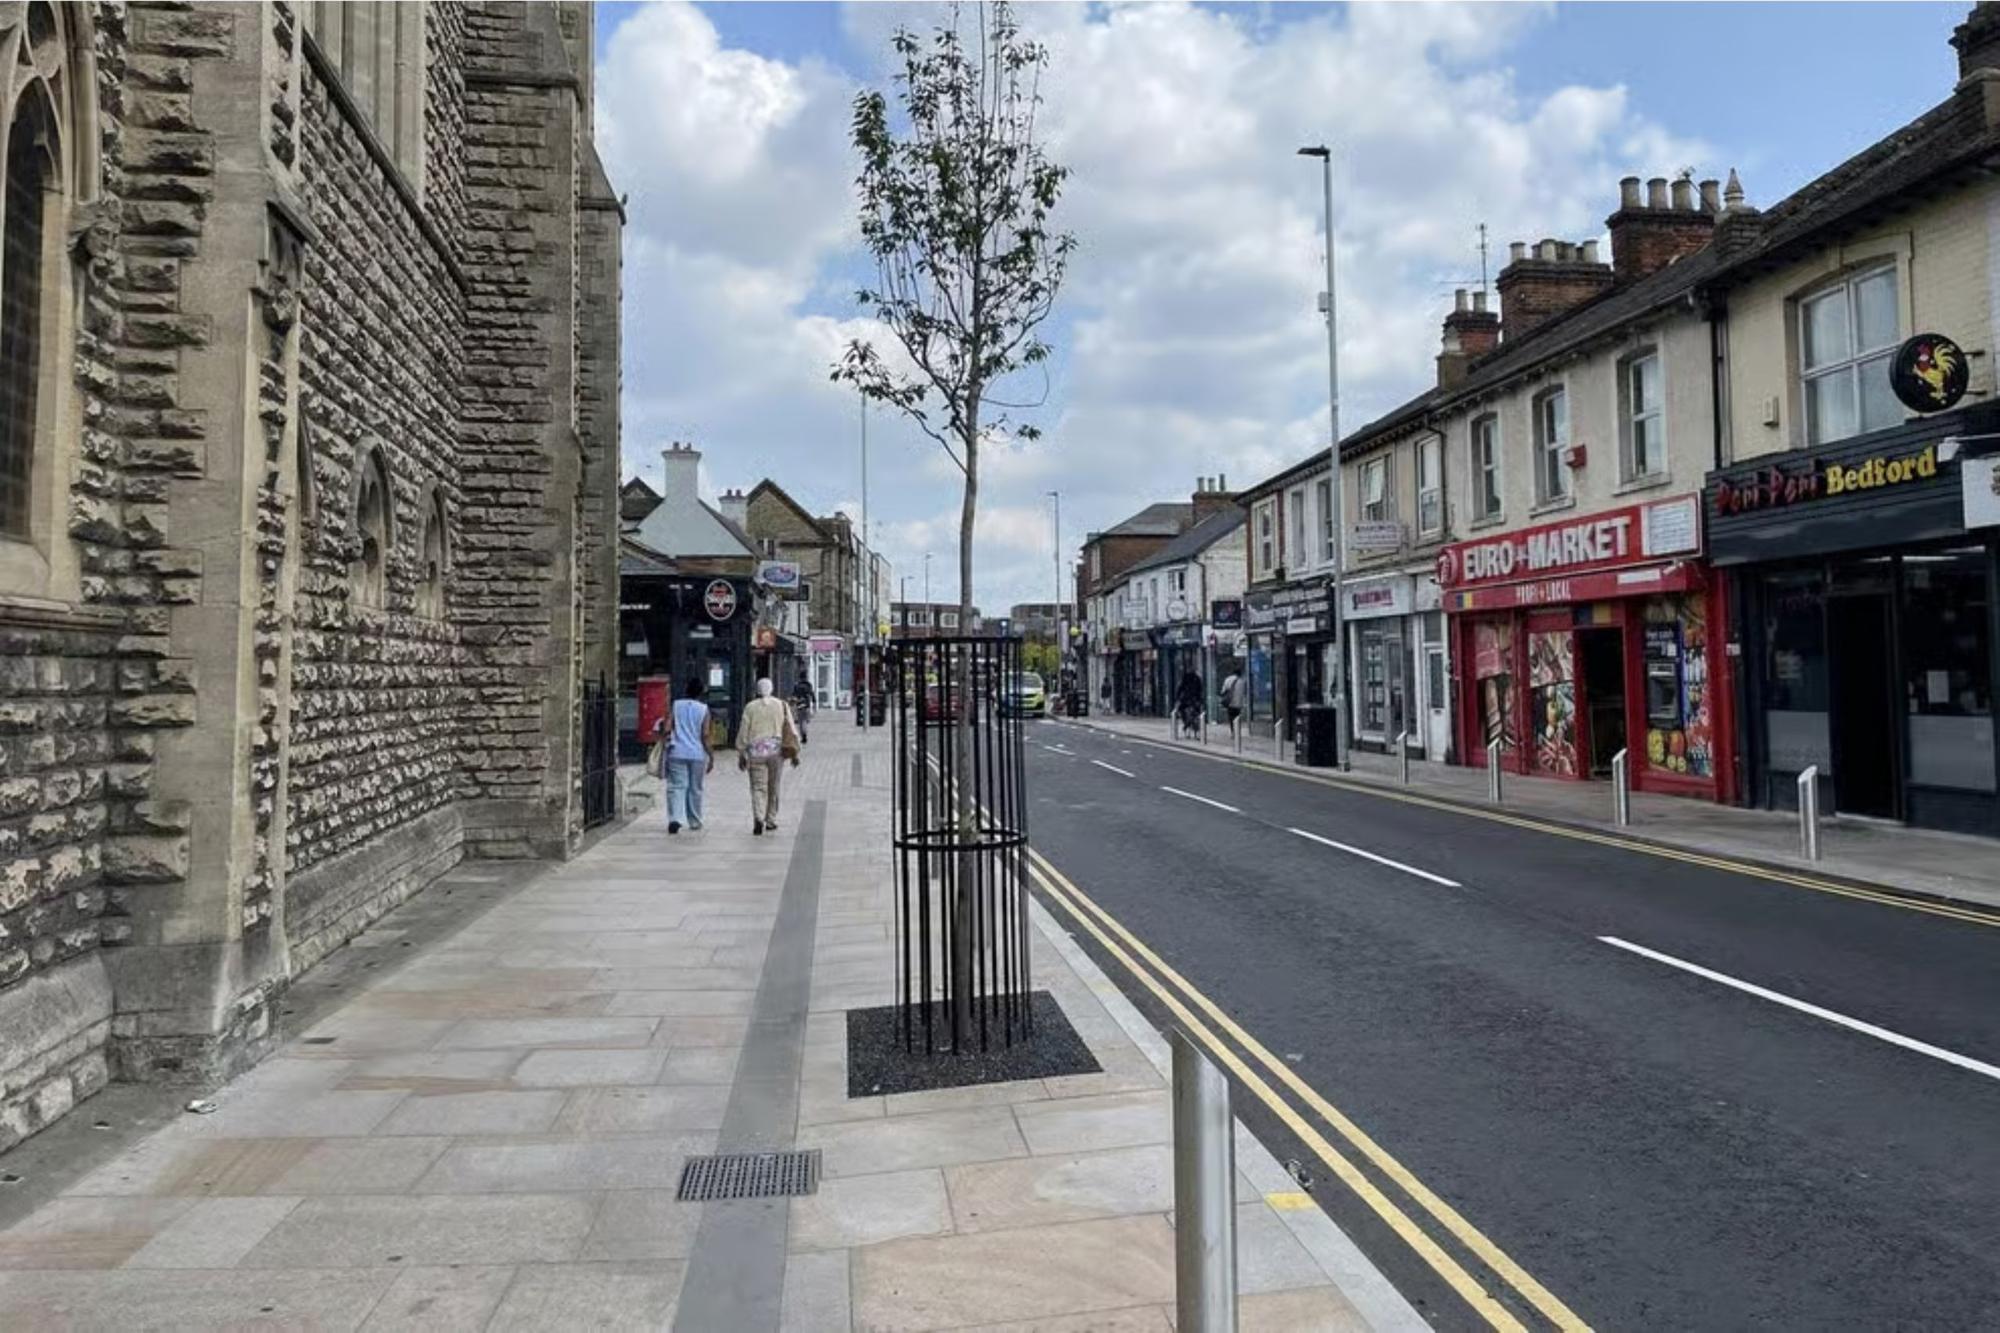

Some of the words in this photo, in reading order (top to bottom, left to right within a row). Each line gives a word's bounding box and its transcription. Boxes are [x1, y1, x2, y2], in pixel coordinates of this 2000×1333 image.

[1826, 447, 1935, 494] Bedford
[1463, 543, 1513, 580] EURO
[1529, 517, 1629, 569] MARKET
